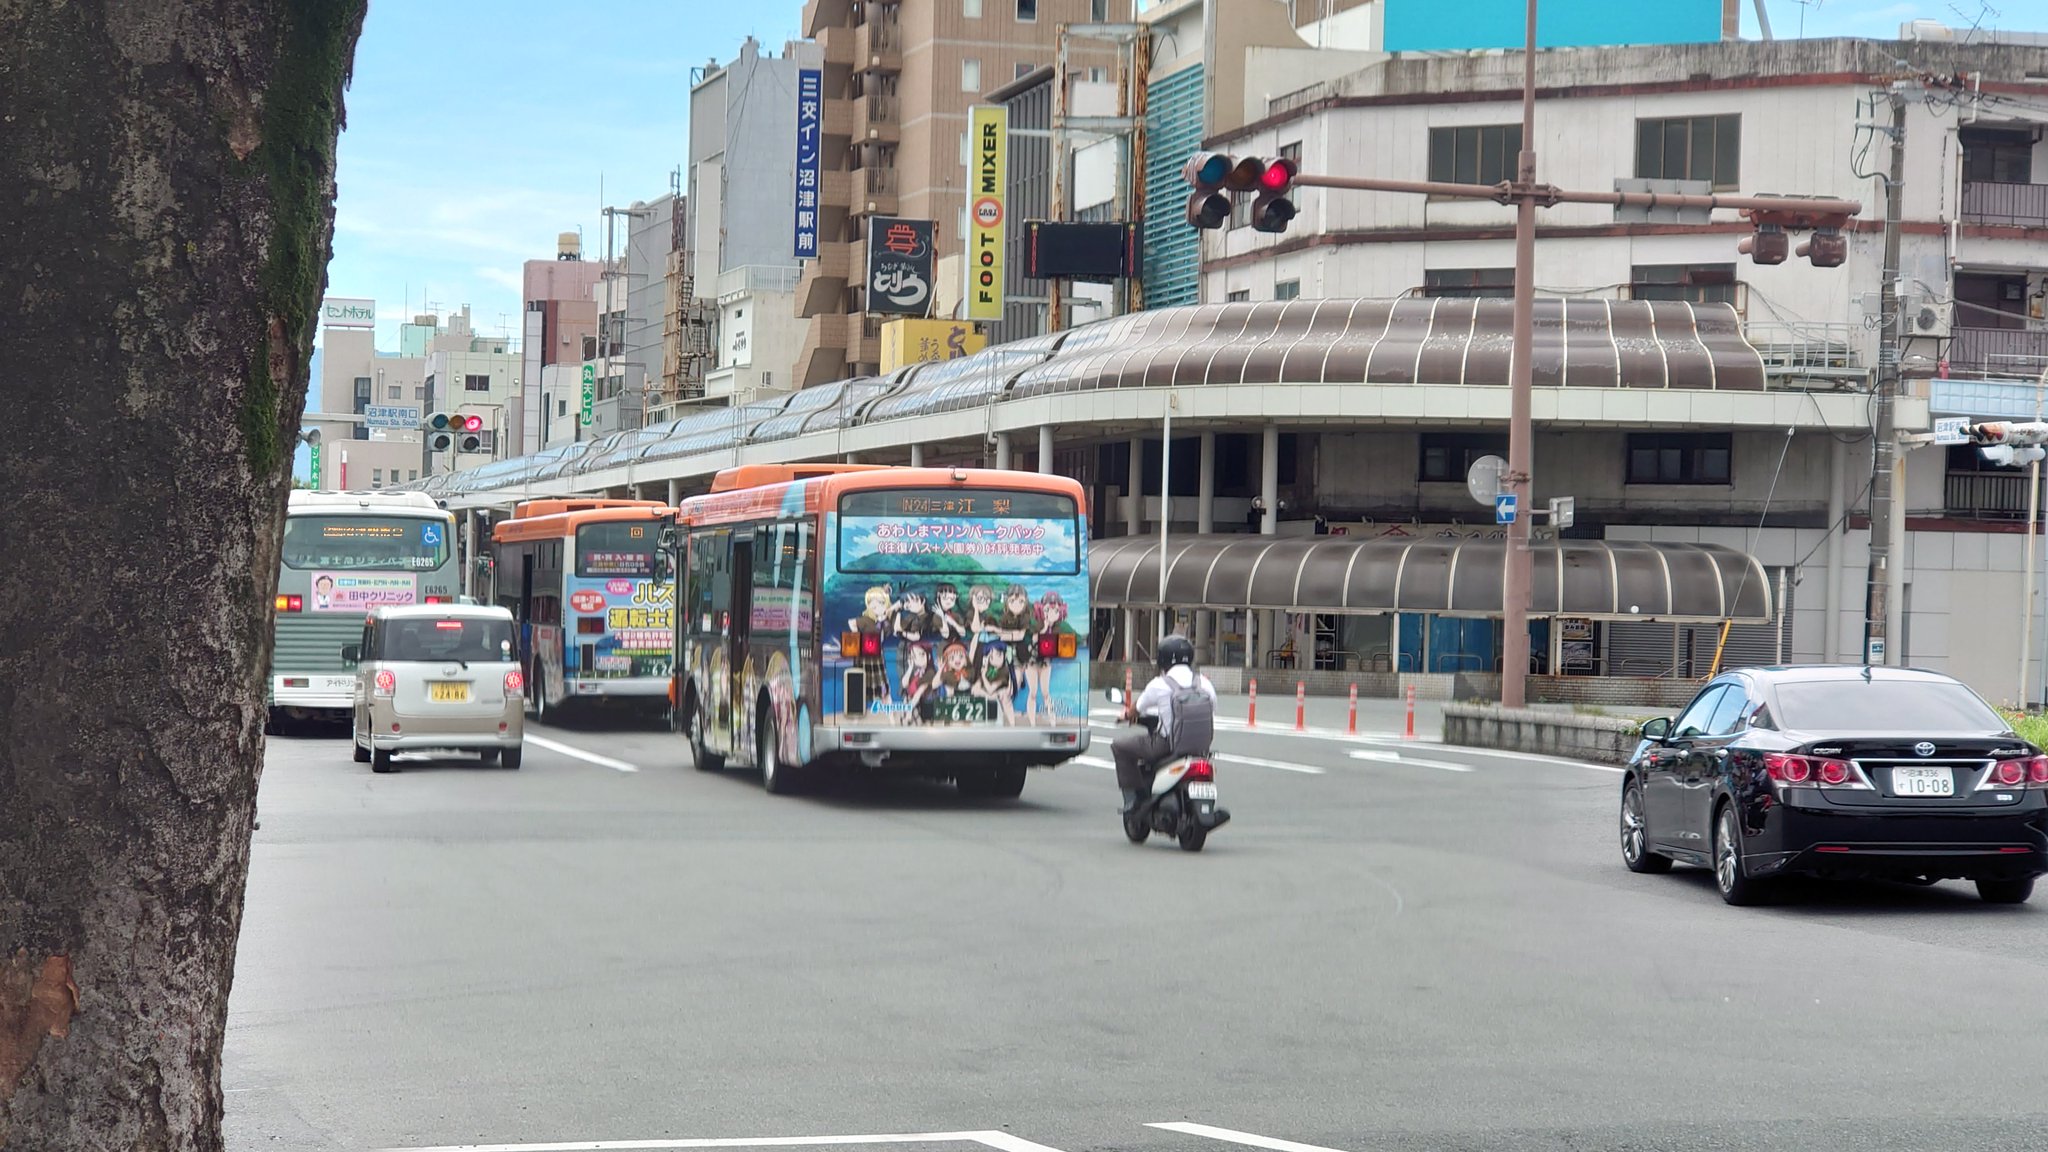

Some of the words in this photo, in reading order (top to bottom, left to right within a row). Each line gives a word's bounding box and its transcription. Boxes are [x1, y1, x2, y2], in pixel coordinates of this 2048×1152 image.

[798, 77, 818, 250] 三交イン沼津駅前
[982, 122, 997, 193] MIXER
[979, 232, 995, 303] FOOT
[326, 304, 374, 319] セントホテル
[582, 368, 593, 423] 丸天ビル
[367, 407, 418, 419] 沼津駅南口
[366, 418, 389, 426] Numazu
[402, 419, 418, 427] South
[903, 499, 928, 513] N24
[349, 591, 414, 602] 田中クリニック
[951, 702, 985, 722] 622
[1908, 779, 1950, 793] 10-08
